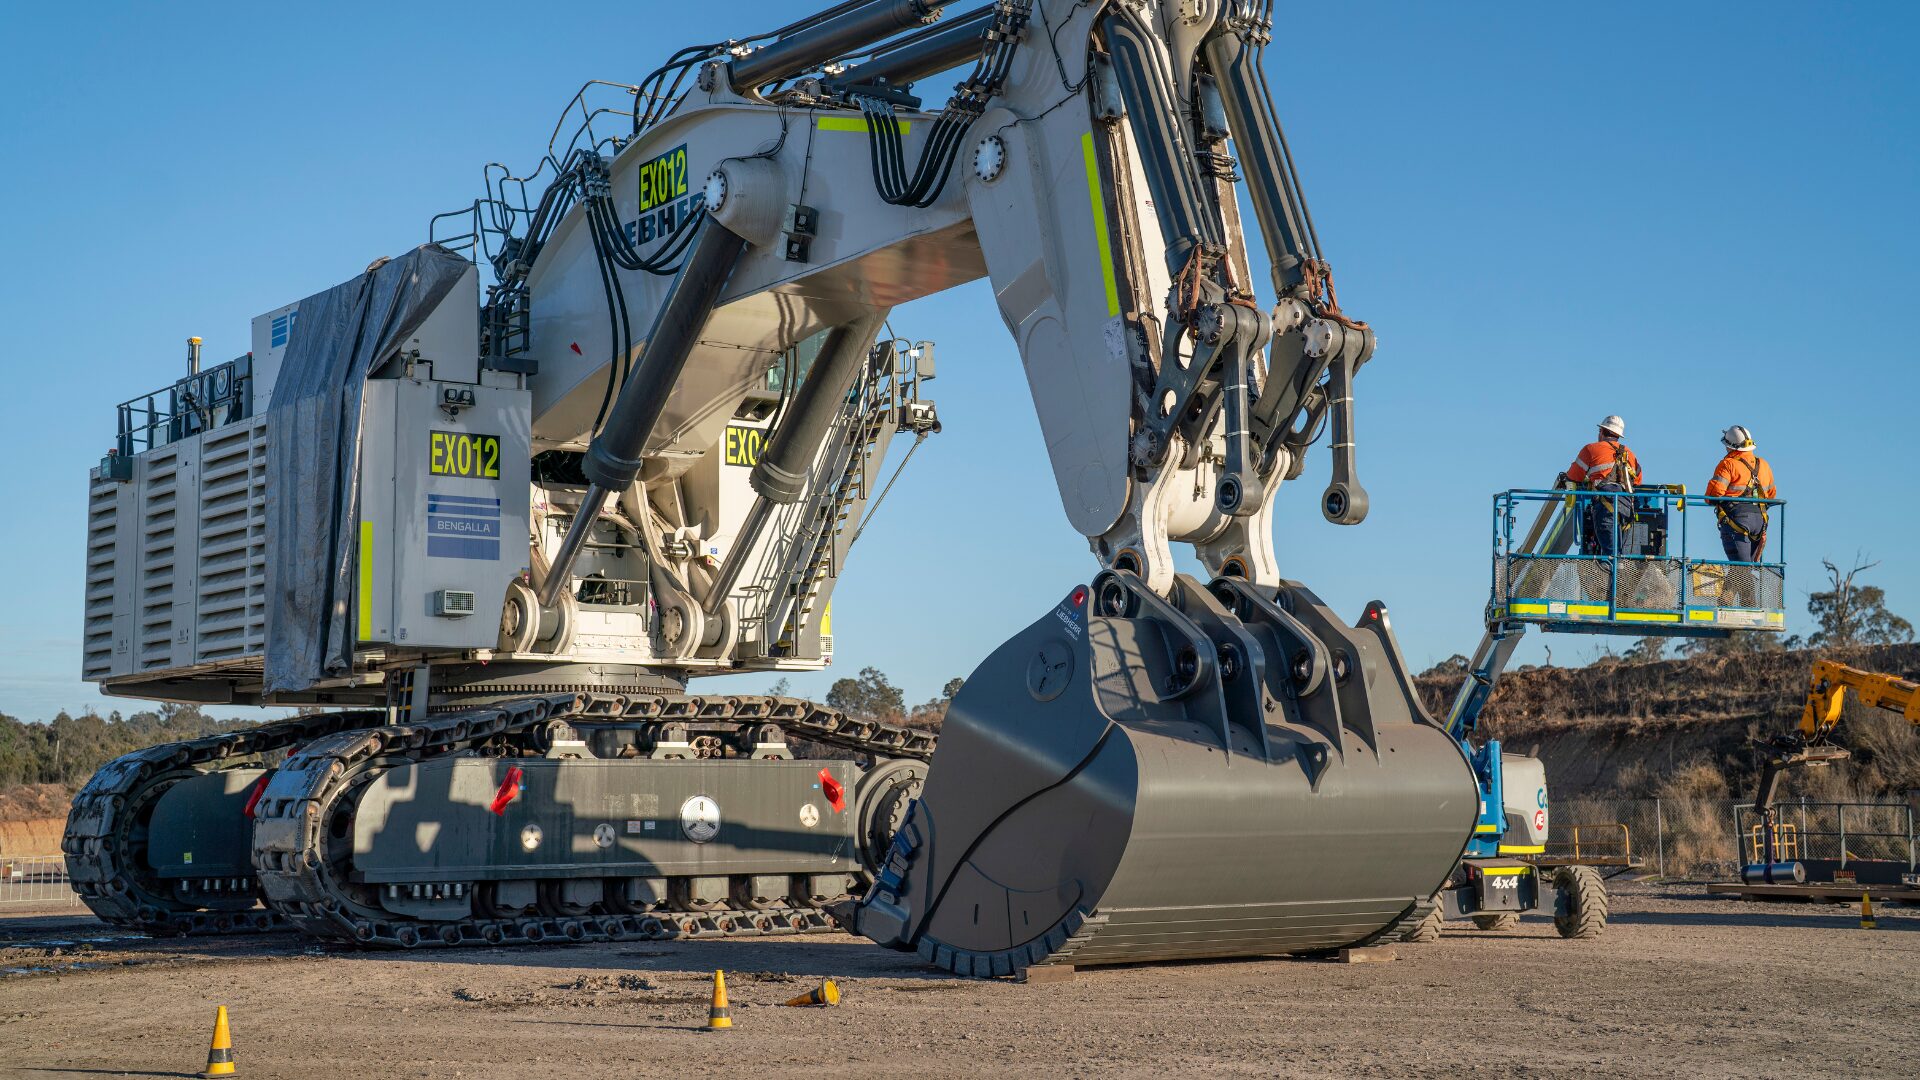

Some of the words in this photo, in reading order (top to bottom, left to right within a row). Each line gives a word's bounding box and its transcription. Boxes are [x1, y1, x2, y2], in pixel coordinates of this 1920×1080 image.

[640, 149, 687, 211] EX012
[431, 433, 498, 477] EX012
[437, 520, 491, 533] BENGALLA
[1056, 608, 1081, 635] LIEBHERR
[1492, 876, 1519, 889] 4x4
